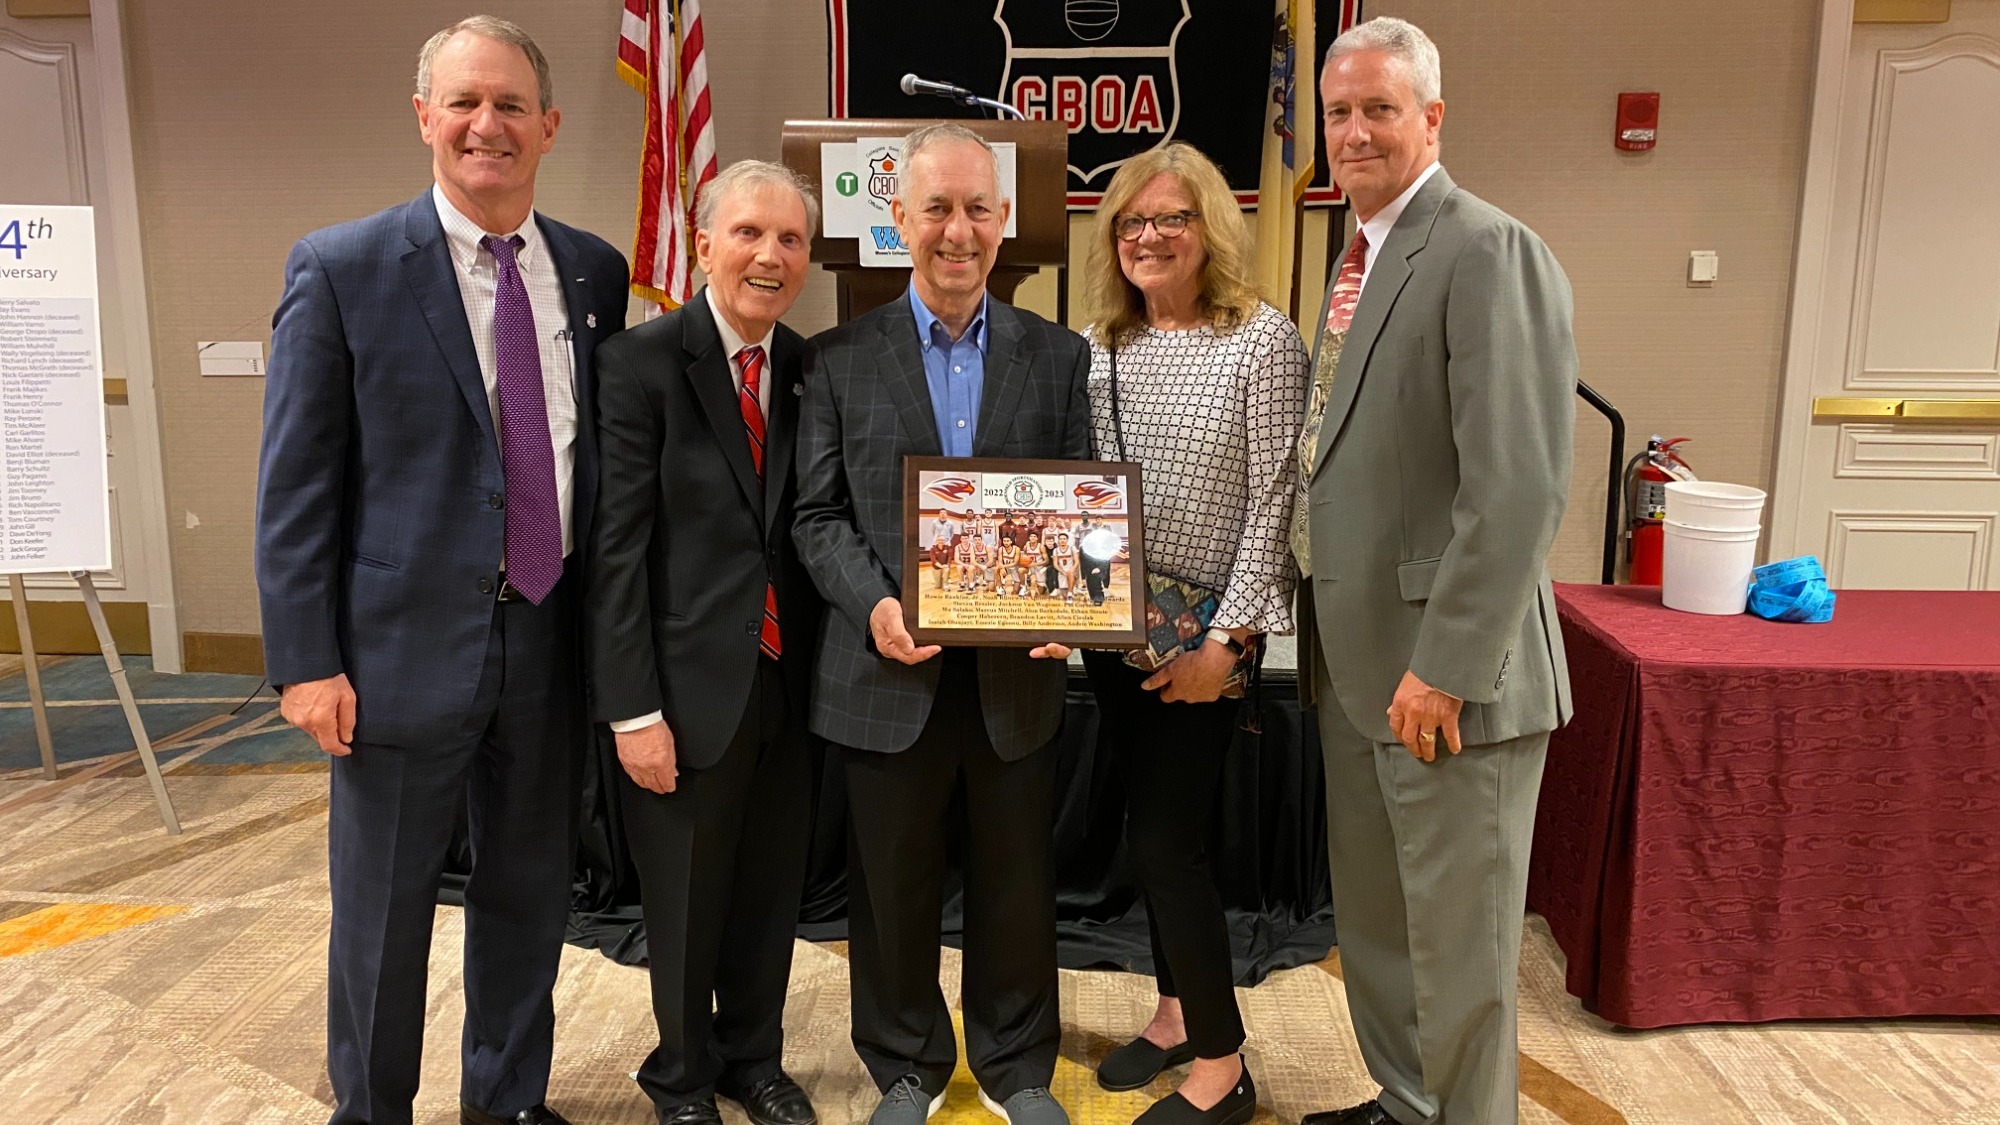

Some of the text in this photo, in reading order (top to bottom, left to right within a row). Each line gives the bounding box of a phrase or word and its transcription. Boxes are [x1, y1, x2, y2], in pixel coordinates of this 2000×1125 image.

[1011, 74, 1166, 134] CBOA
[984, 488, 1064, 498] 2022 2023
